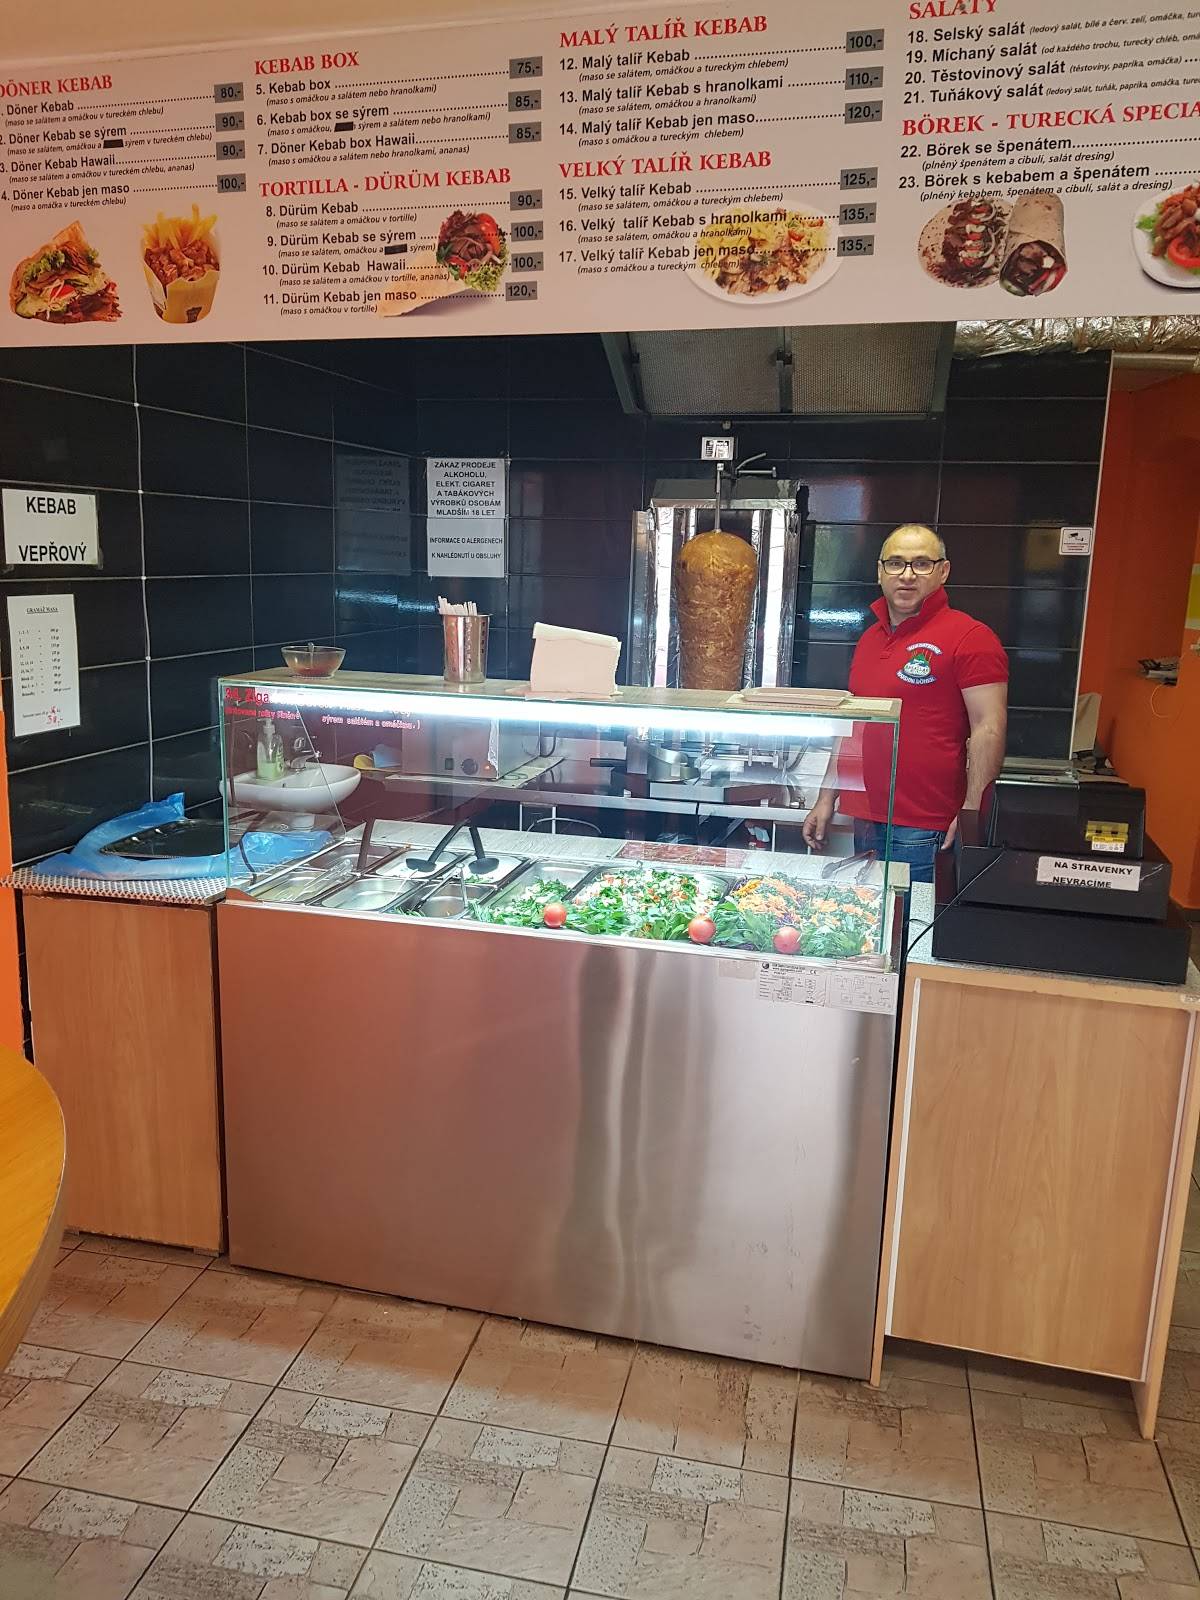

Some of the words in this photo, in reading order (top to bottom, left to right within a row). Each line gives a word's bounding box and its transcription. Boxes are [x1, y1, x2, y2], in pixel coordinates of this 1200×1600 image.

[560, 23, 619, 48] MALÝ
[625, 17, 688, 42] TALÍŘ
[694, 16, 767, 36] KEBAB
[908, 30, 928, 44] 18.
[934, 25, 984, 42] Selský
[988, 21, 1025, 37] salát
[255, 56, 315, 75] KEBAB
[321, 51, 359, 69] BOX
[560, 58, 578, 70] 12.
[582, 54, 613, 70] Malý
[617, 52, 643, 66] talíř
[647, 49, 690, 64] Kebab
[849, 35, 883, 49] 100,-
[906, 50, 927, 64] 19.
[932, 44, 995, 62] Míchaný
[1000, 42, 1037, 57] salát
[57, 75, 112, 93] KEBAB
[256, 84, 265, 95] 5.
[269, 80, 306, 94] Kebab
[309, 79, 331, 90] box
[517, 61, 540, 75] 75,-
[905, 71, 925, 85] 20.
[931, 63, 1023, 83] Těstovinový
[1028, 60, 1065, 76] salát
[560, 91, 577, 103] 13.
[582, 88, 612, 103] Malý
[616, 85, 642, 99] talíř
[646, 82, 689, 97] Kebab
[693, 84, 701, 94] s
[706, 75, 783, 93] hranolkami
[849, 72, 879, 86] 110,-
[904, 91, 924, 104] 21.
[930, 85, 1002, 102] Tuňákový
[1006, 83, 1044, 98] salát
[257, 114, 266, 126] 6.
[270, 111, 306, 124] Kebab
[310, 110, 332, 121] box
[335, 110, 349, 119] se
[353, 105, 389, 121] sýrem
[515, 95, 539, 109] 85,-
[902, 114, 984, 136] BÖREK
[1006, 103, 1115, 129] TURECKÁ
[9, 133, 40, 144] Döner
[43, 129, 76, 142] Kebab
[79, 130, 91, 139] se
[94, 126, 127, 140] sýrem
[222, 116, 244, 128] 90,-
[901, 145, 921, 158] 22.
[927, 142, 970, 156] Börek
[975, 144, 992, 154] se
[558, 155, 625, 178] VELKÝ
[631, 151, 693, 174] TALÍŘ
[700, 151, 771, 170] KEBAB
[1, 190, 10, 201] 4.
[13, 189, 44, 200] Döner
[47, 186, 79, 198] Kebab
[81, 185, 98, 199] jen
[101, 185, 130, 195] maso
[219, 177, 245, 190] 100,-
[259, 178, 349, 197] TORTILLA
[365, 169, 440, 191] DÜRÜM
[446, 168, 511, 186] KEBAB
[559, 188, 577, 200] 15.
[581, 185, 616, 201] Velký
[620, 184, 645, 197] talíř
[649, 182, 691, 195] Kebab
[844, 172, 876, 187] 125,-
[898, 176, 919, 189] 23.
[925, 173, 968, 187] Börek
[973, 175, 981, 185] s
[986, 170, 1054, 184] kebabem
[1060, 171, 1068, 180] a
[1073, 165, 1149, 181] špenátem
[266, 206, 276, 217] 8.
[279, 204, 317, 216] Dürüm
[321, 201, 358, 214] Kebab
[518, 194, 540, 208] 90,-
[267, 236, 277, 247] 9.
[280, 234, 318, 246] Dürüm
[322, 232, 359, 244] Kebab
[363, 233, 376, 242] se
[380, 229, 416, 244] sýrem
[514, 225, 543, 239] 100,-
[264, 293, 279, 304] 11.
[282, 292, 320, 304] Dürüm
[324, 291, 360, 303] Kebab
[363, 290, 381, 304] jen
[385, 291, 417, 301] maso
[508, 285, 536, 297] 120,-
[26, 496, 76, 515] KEBAB
[18, 541, 87, 562] VEPŘOVÝ
[1054, 861, 1068, 869] NA
[1071, 863, 1133, 875] STRAVENKY
[1052, 875, 1112, 888] NEVRACÍME
